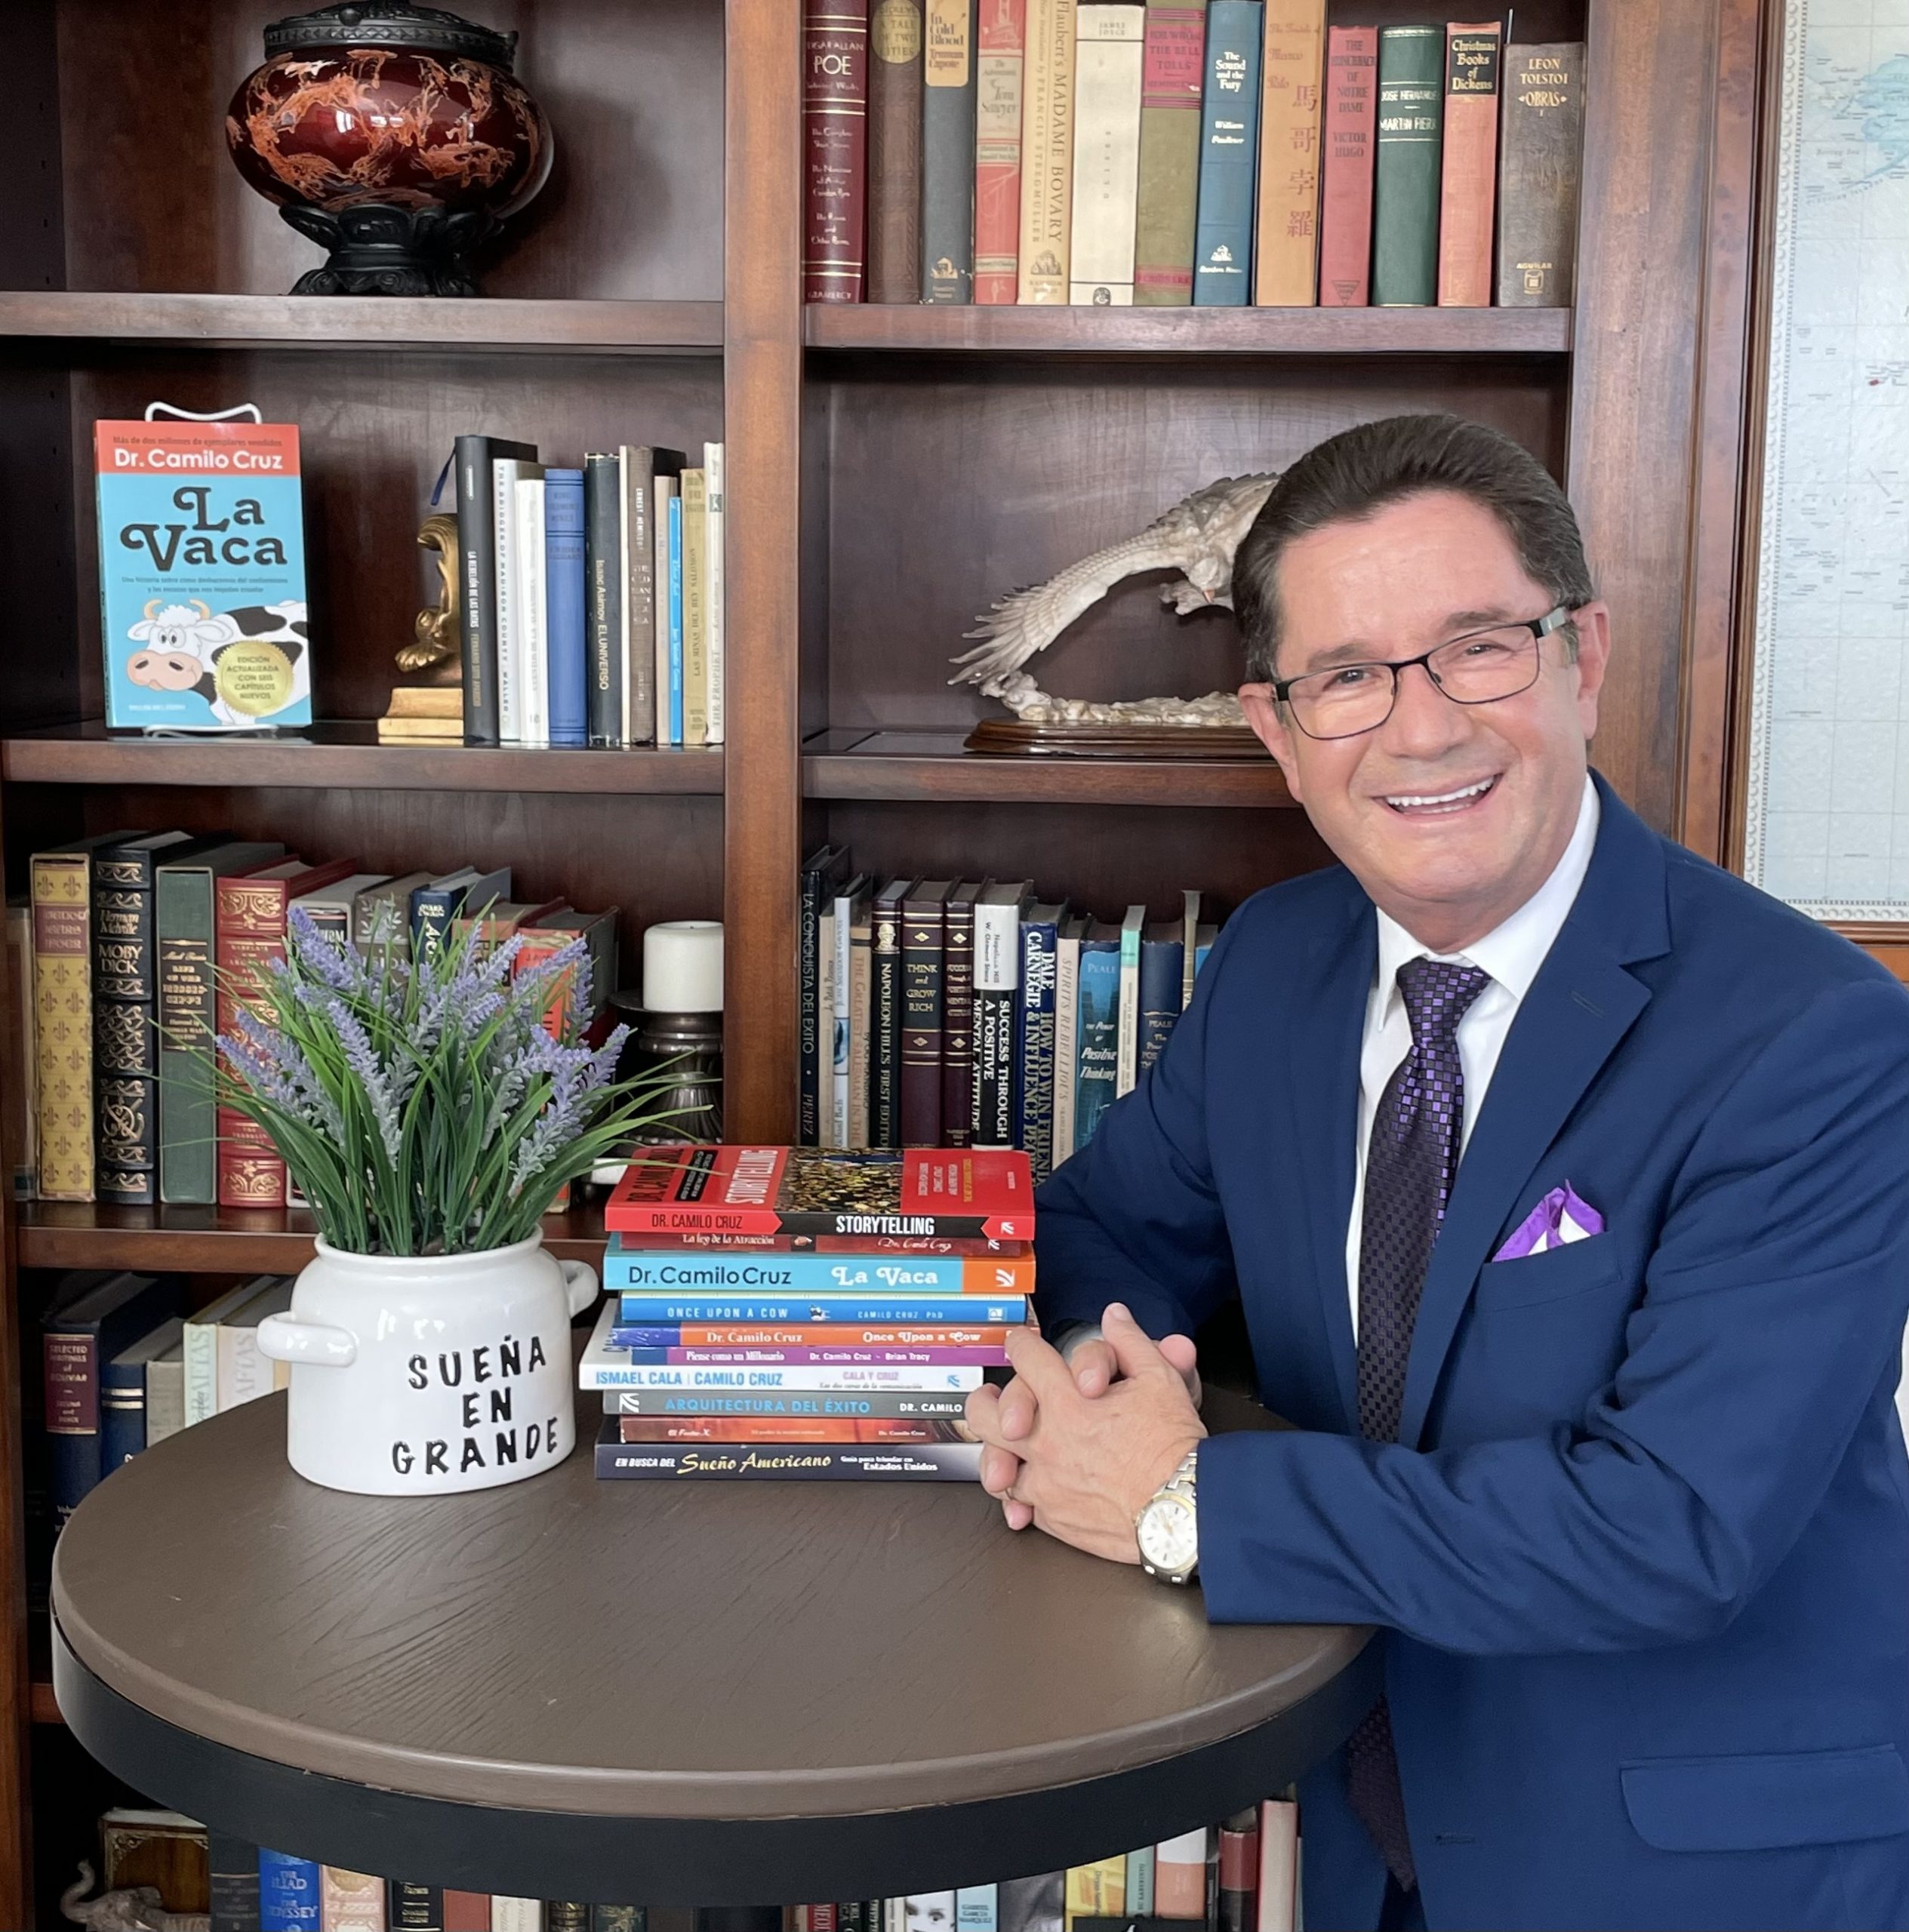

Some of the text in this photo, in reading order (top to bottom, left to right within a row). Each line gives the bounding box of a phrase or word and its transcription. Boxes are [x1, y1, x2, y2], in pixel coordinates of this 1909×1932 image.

[929, 24, 955, 35] Cold
[930, 35, 964, 46] Blood
[1345, 39, 1363, 51] THE
[1451, 38, 1497, 52] Christmas
[1150, 45, 1200, 56] THE BELL
[1223, 51, 1240, 60] The
[814, 54, 852, 75] POE
[1157, 60, 1192, 70] TOLLS
[1215, 59, 1246, 70] Sound
[1455, 53, 1491, 66] Books
[1528, 57, 1562, 70] LEON
[1346, 71, 1359, 82] OF
[1467, 66, 1479, 79] of
[1519, 72, 1569, 85] TOLSTOI
[1219, 78, 1242, 92] Fury
[1452, 77, 1494, 91] Dickens
[1336, 86, 1369, 98] NOTRE
[1524, 91, 1561, 107] OBRAS
[1338, 102, 1365, 113] DAME
[1051, 73, 1068, 158] MADAME
[1332, 131, 1368, 144] VICTOR
[1335, 146, 1365, 158] HUGO
[1048, 166, 1064, 242] BOVARY
[114, 448, 283, 469] Dr. Camilo Cruz
[173, 486, 265, 532] La
[120, 524, 288, 573] Vaca
[500, 545, 507, 558] OF
[596, 559, 609, 691] Isaac Asimov EL UNIVERSO
[691, 612, 700, 628] DEL
[691, 632, 700, 657] MINAS
[711, 651, 721, 726] THE PROPHET
[98, 943, 143, 960] MOBY
[101, 959, 140, 974] DICK
[906, 964, 938, 973] THINK
[1025, 931, 1042, 1008] CARNEGIE
[1040, 952, 1055, 990] DALE
[1087, 963, 1116, 974] PEALE
[1061, 957, 1072, 1011] SPIRITS
[906, 989, 936, 998] GROW
[909, 1002, 934, 1011] RICH
[802, 893, 814, 1136] LA CONQUISTA DEL EXITO PEREZ
[1039, 1012, 1054, 1049] HOW
[983, 999, 995, 1081] A POSITIVE
[851, 955, 866, 1142] THE GREATEST SALESMAN IN THE
[1080, 1046, 1118, 1060] Positive
[971, 998, 981, 1131] MENTAL ATTITUDE
[1038, 1053, 1053, 1076] TO
[1059, 1014, 1071, 1102] REBELLIOUS
[996, 1000, 1010, 1139] SUCCESS THROUGH
[1079, 1066, 1116, 1081] Thinking
[1037, 1080, 1053, 1115] WIN
[723, 1149, 779, 1205] STORYTELLING
[651, 1214, 743, 1229] DR. CAMILO CRUZ
[836, 1215, 935, 1235] STORYTELLING
[629, 1266, 793, 1285] Dr. Camilo Cruz
[831, 1266, 939, 1287] La Vaca
[667, 1307, 789, 1319] ONCE UPON A COW
[706, 1331, 803, 1343] Dr. Camilo Cruz
[408, 1335, 547, 1389] SUEÑA
[595, 1371, 784, 1386] ISMAEL CALA CAMILO CRUZ
[842, 1371, 901, 1381] CALA Y CRUZ
[463, 1386, 513, 1429] EN
[664, 1398, 963, 1414] ARQUITECTURA DEL ÉXITO DR. CAMILO
[392, 1417, 559, 1475] GRANDE
[614, 1452, 832, 1475] EN BUSCA DEL Sueño Americano
[863, 1462, 938, 1472] Estados Unidos
